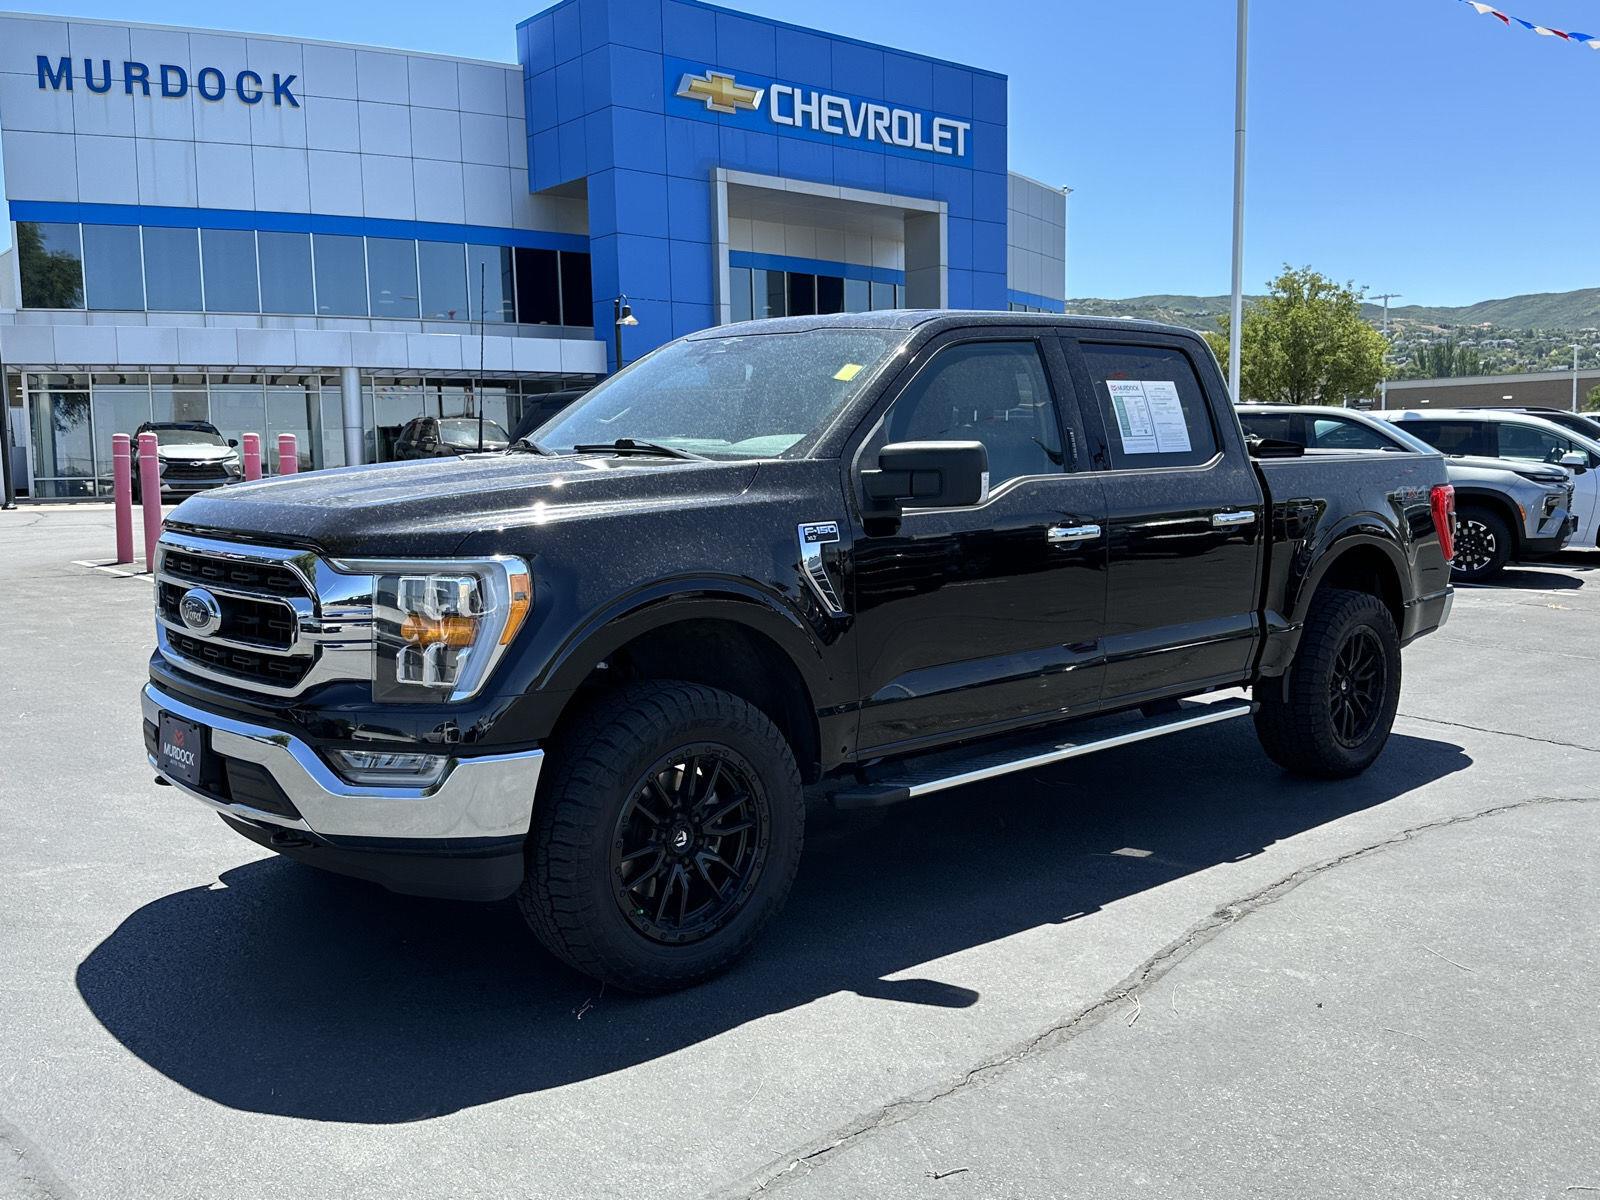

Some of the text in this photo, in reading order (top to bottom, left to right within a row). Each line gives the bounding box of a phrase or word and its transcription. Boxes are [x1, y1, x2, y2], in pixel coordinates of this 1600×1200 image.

[36, 54, 300, 108] MURDOCK
[769, 83, 971, 157] CHEVROLET
[804, 525, 837, 535] F-150
[163, 741, 195, 767] MURDOCK
